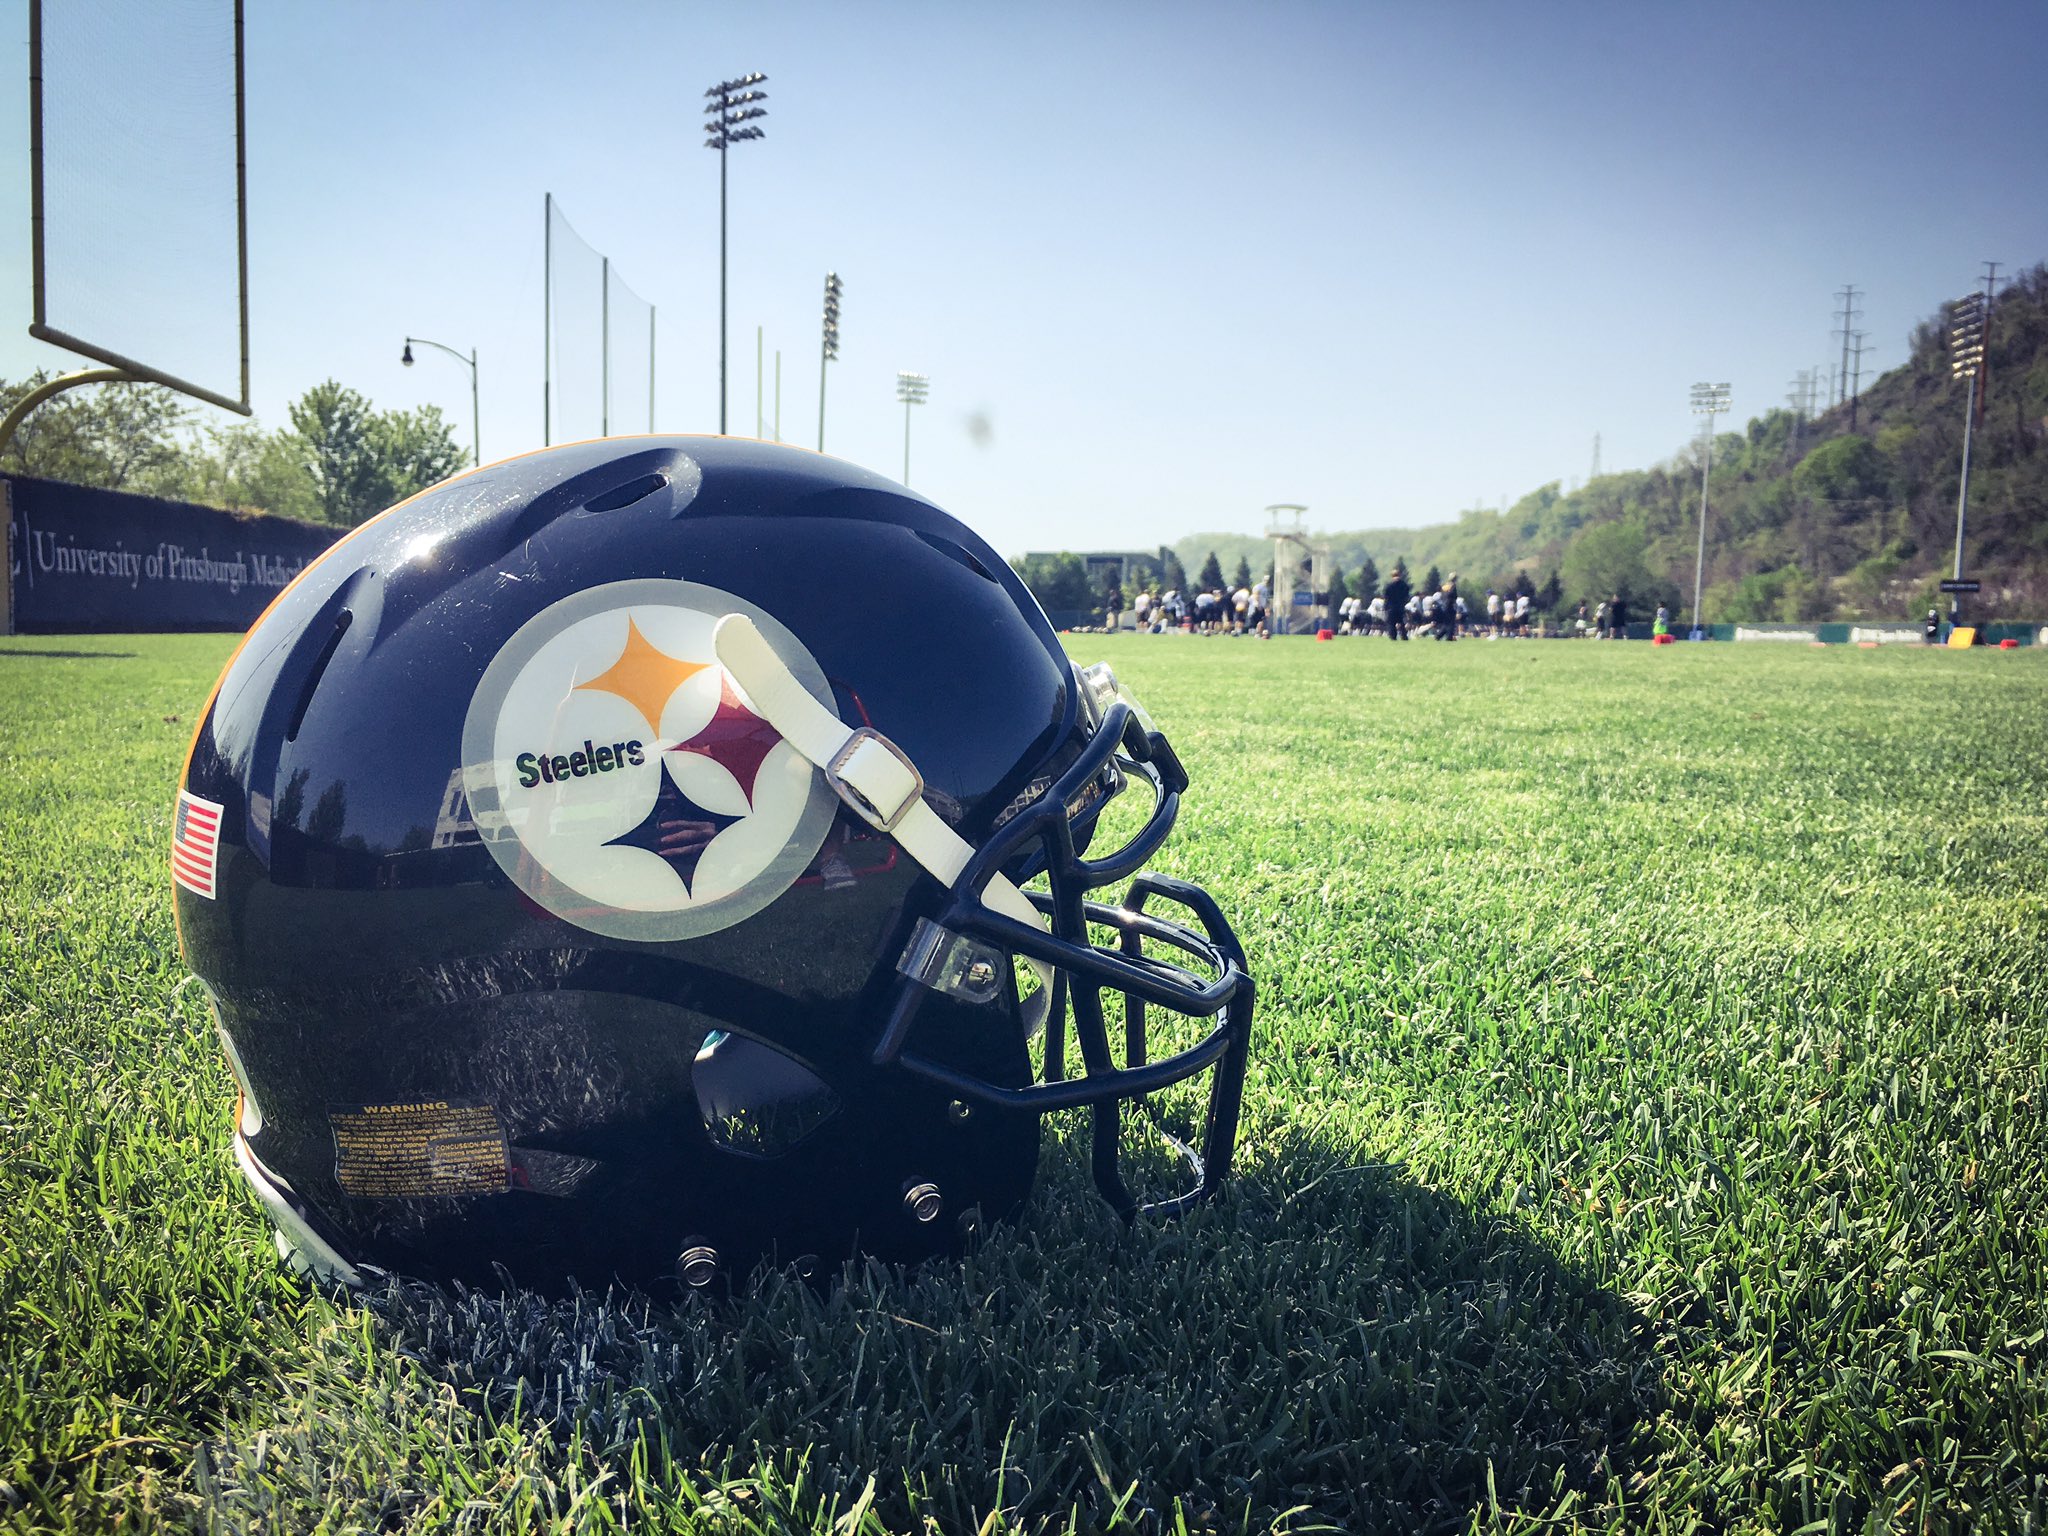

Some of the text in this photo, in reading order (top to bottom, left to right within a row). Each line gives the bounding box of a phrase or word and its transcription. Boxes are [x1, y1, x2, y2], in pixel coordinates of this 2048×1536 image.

[33, 530, 141, 589] University
[145, 543, 166, 580] of
[167, 544, 248, 594] Pittsburgh
[516, 740, 645, 788] Steelers
[363, 1101, 449, 1114] WARNING
